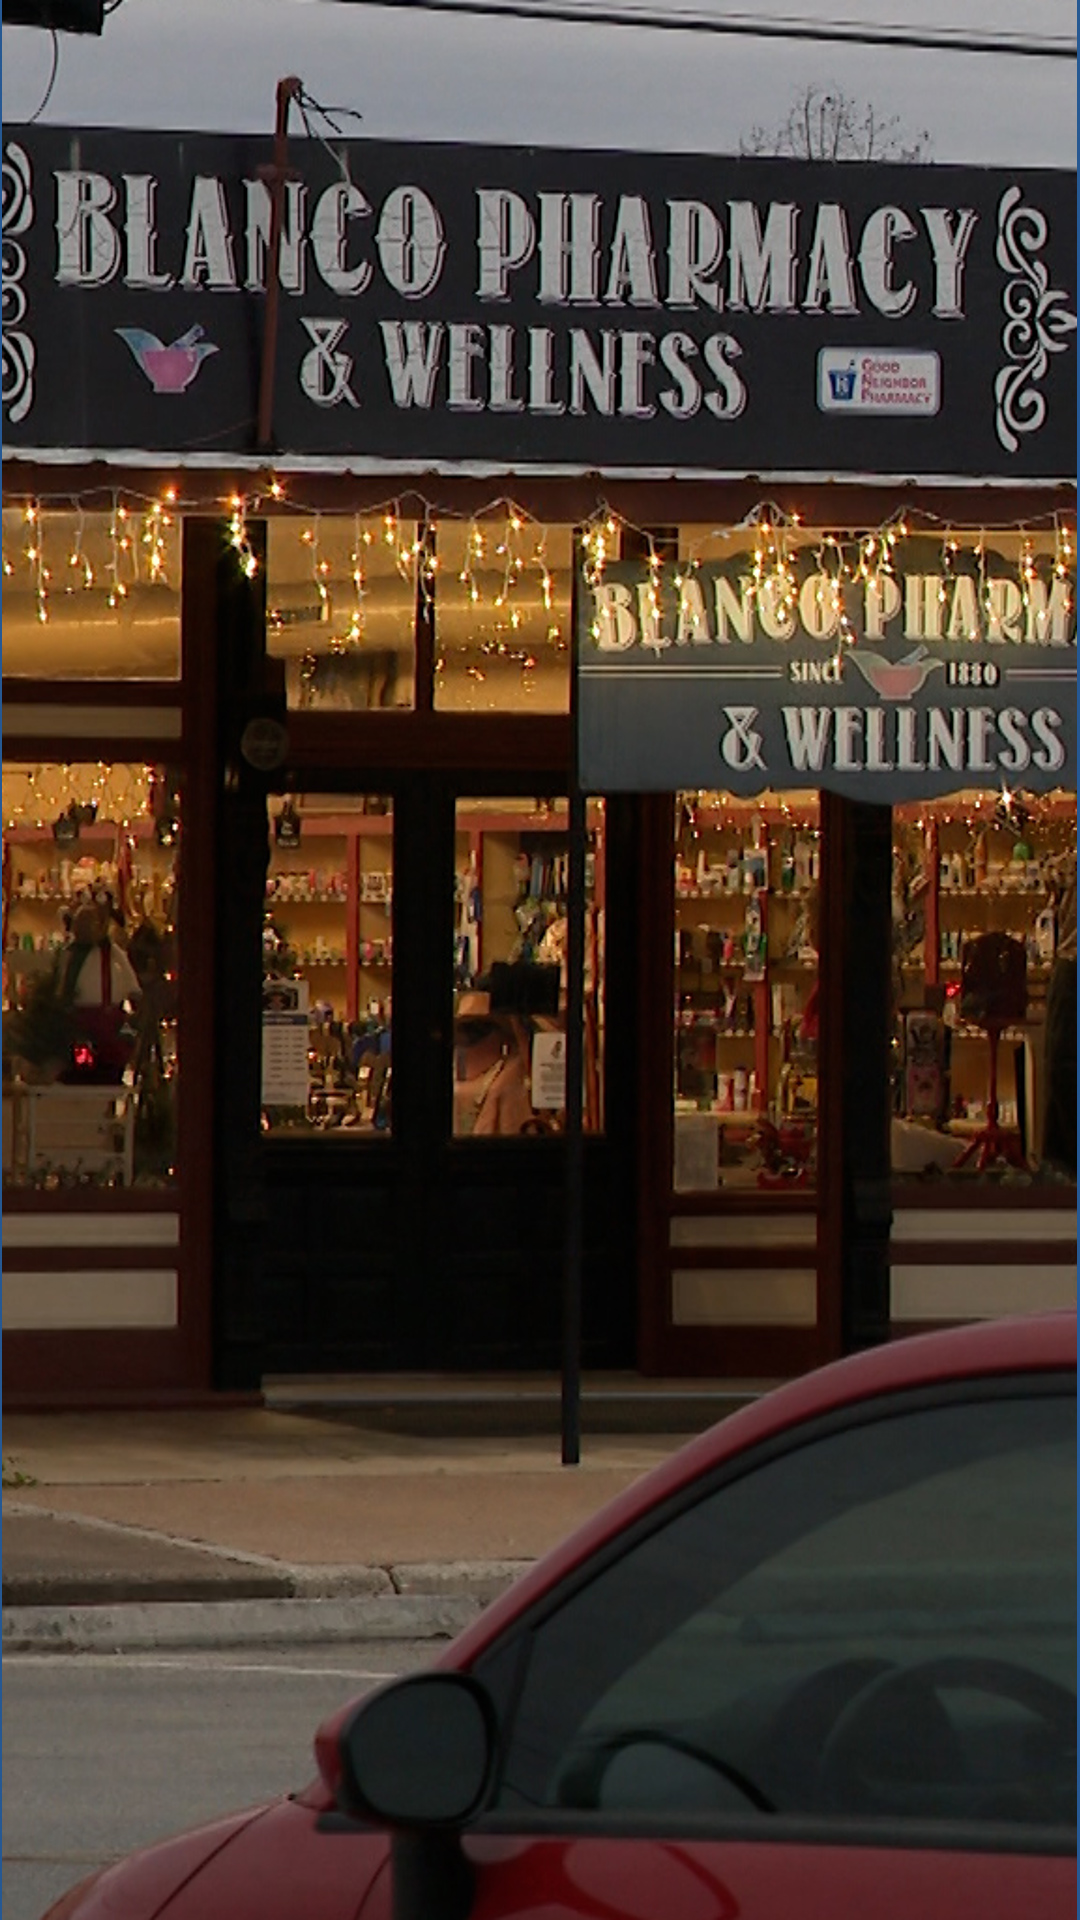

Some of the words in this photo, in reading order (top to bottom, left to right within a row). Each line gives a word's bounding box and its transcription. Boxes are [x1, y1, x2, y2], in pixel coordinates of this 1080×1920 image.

[53, 170, 447, 300] BLANCO
[475, 187, 979, 320] PHARMACY
[300, 317, 361, 408] &
[379, 319, 747, 420] WELLNESS
[592, 572, 841, 652] BLANCO
[863, 571, 1077, 648] PHARM
[721, 706, 767, 771] &
[781, 706, 1065, 772] WELLNESS
